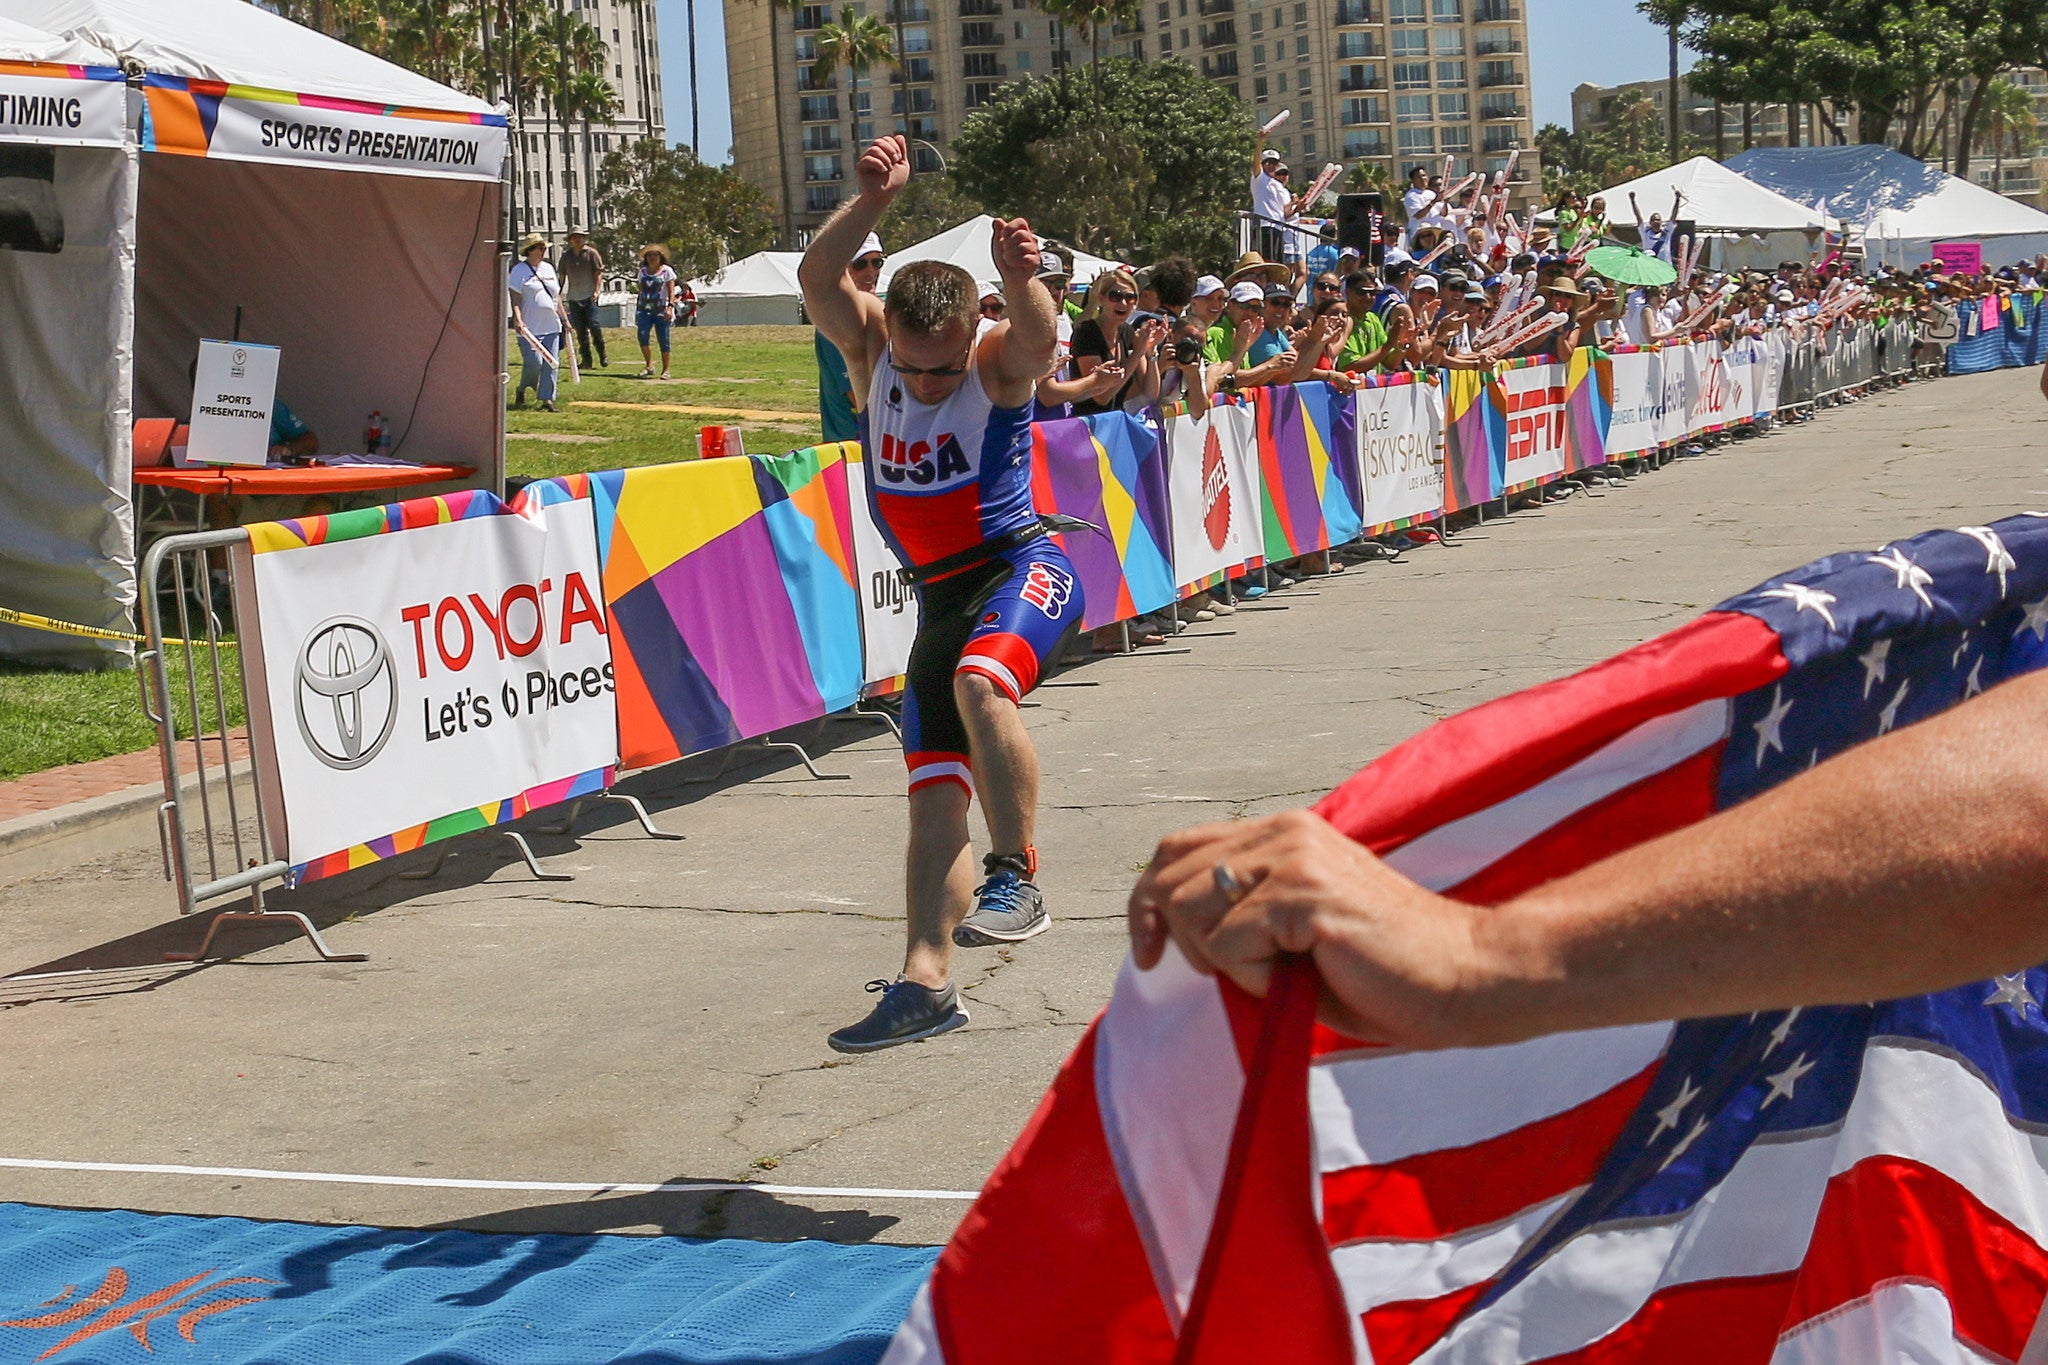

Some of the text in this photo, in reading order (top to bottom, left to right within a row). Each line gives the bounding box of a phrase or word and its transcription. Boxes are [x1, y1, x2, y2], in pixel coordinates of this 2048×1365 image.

[0, 95, 81, 128] TIMING
[261, 119, 478, 165] SPORTS PRESENTATION
[199, 406, 265, 420] PRESENTATION
[217, 394, 252, 405] SPORTS
[880, 432, 971, 485] USA
[1021, 562, 1072, 618] USA
[401, 571, 608, 679] TOYOA
[424, 687, 492, 742] Let's
